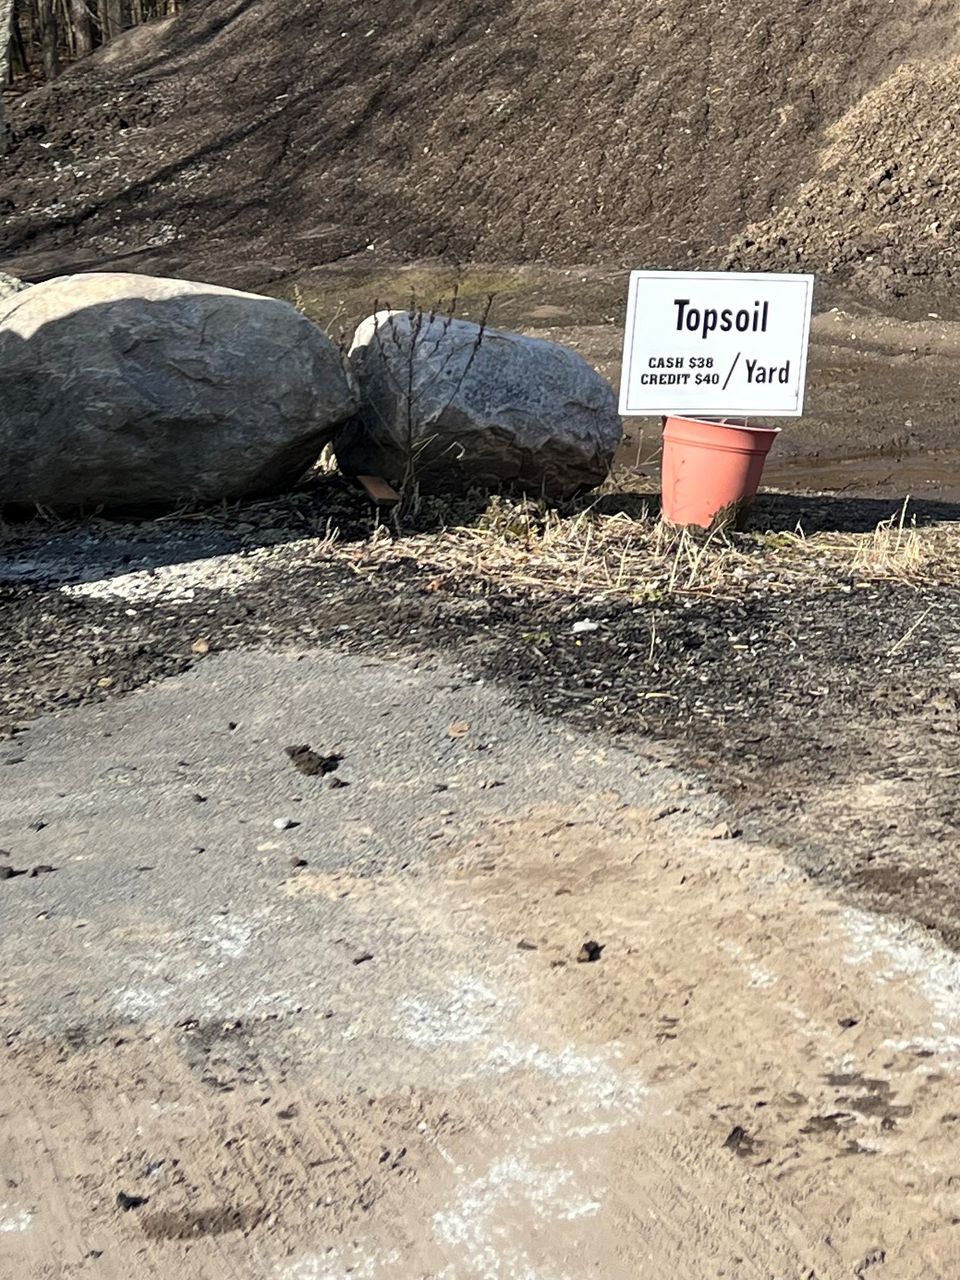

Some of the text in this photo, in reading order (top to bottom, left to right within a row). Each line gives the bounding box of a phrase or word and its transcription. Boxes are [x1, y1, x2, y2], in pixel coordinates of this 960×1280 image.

[674, 299, 769, 339] Topsoil
[648, 356, 714, 369] CASH $38
[640, 372, 720, 385] CREDIT $40
